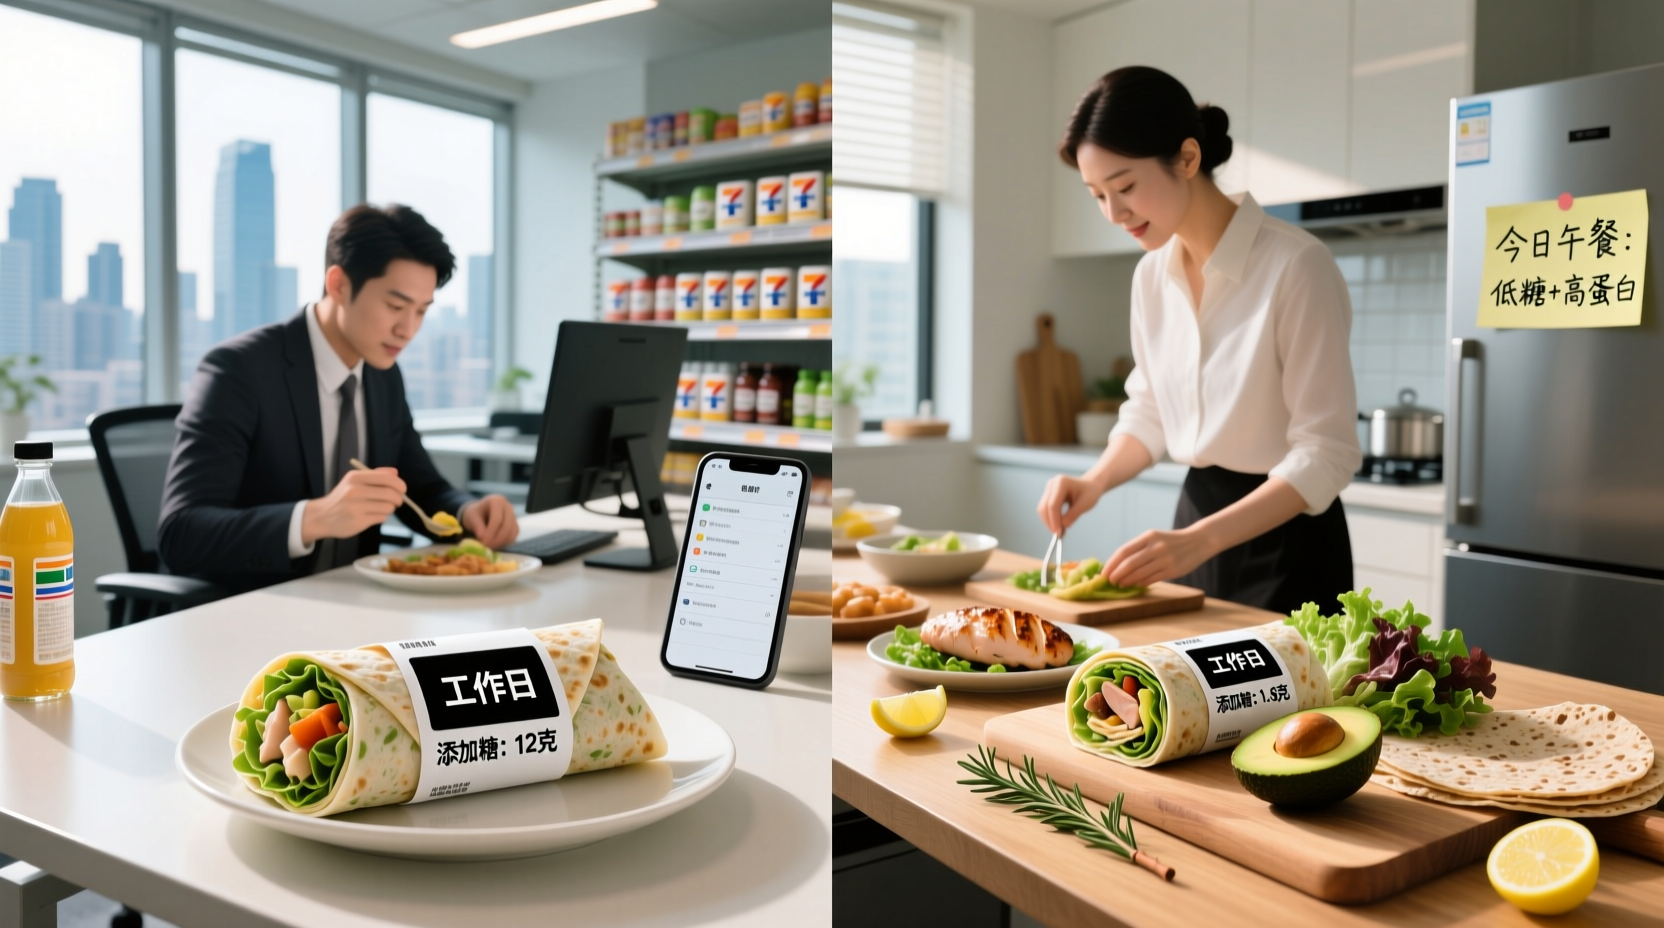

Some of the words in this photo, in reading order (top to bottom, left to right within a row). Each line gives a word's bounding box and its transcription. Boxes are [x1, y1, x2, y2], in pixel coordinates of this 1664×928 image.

[1495, 218, 1632, 263] 今日午餐：
[1490, 273, 1636, 307] 低糖+高蛋白
[1207, 649, 1266, 674] 工作日
[441, 668, 537, 707] 工作日
